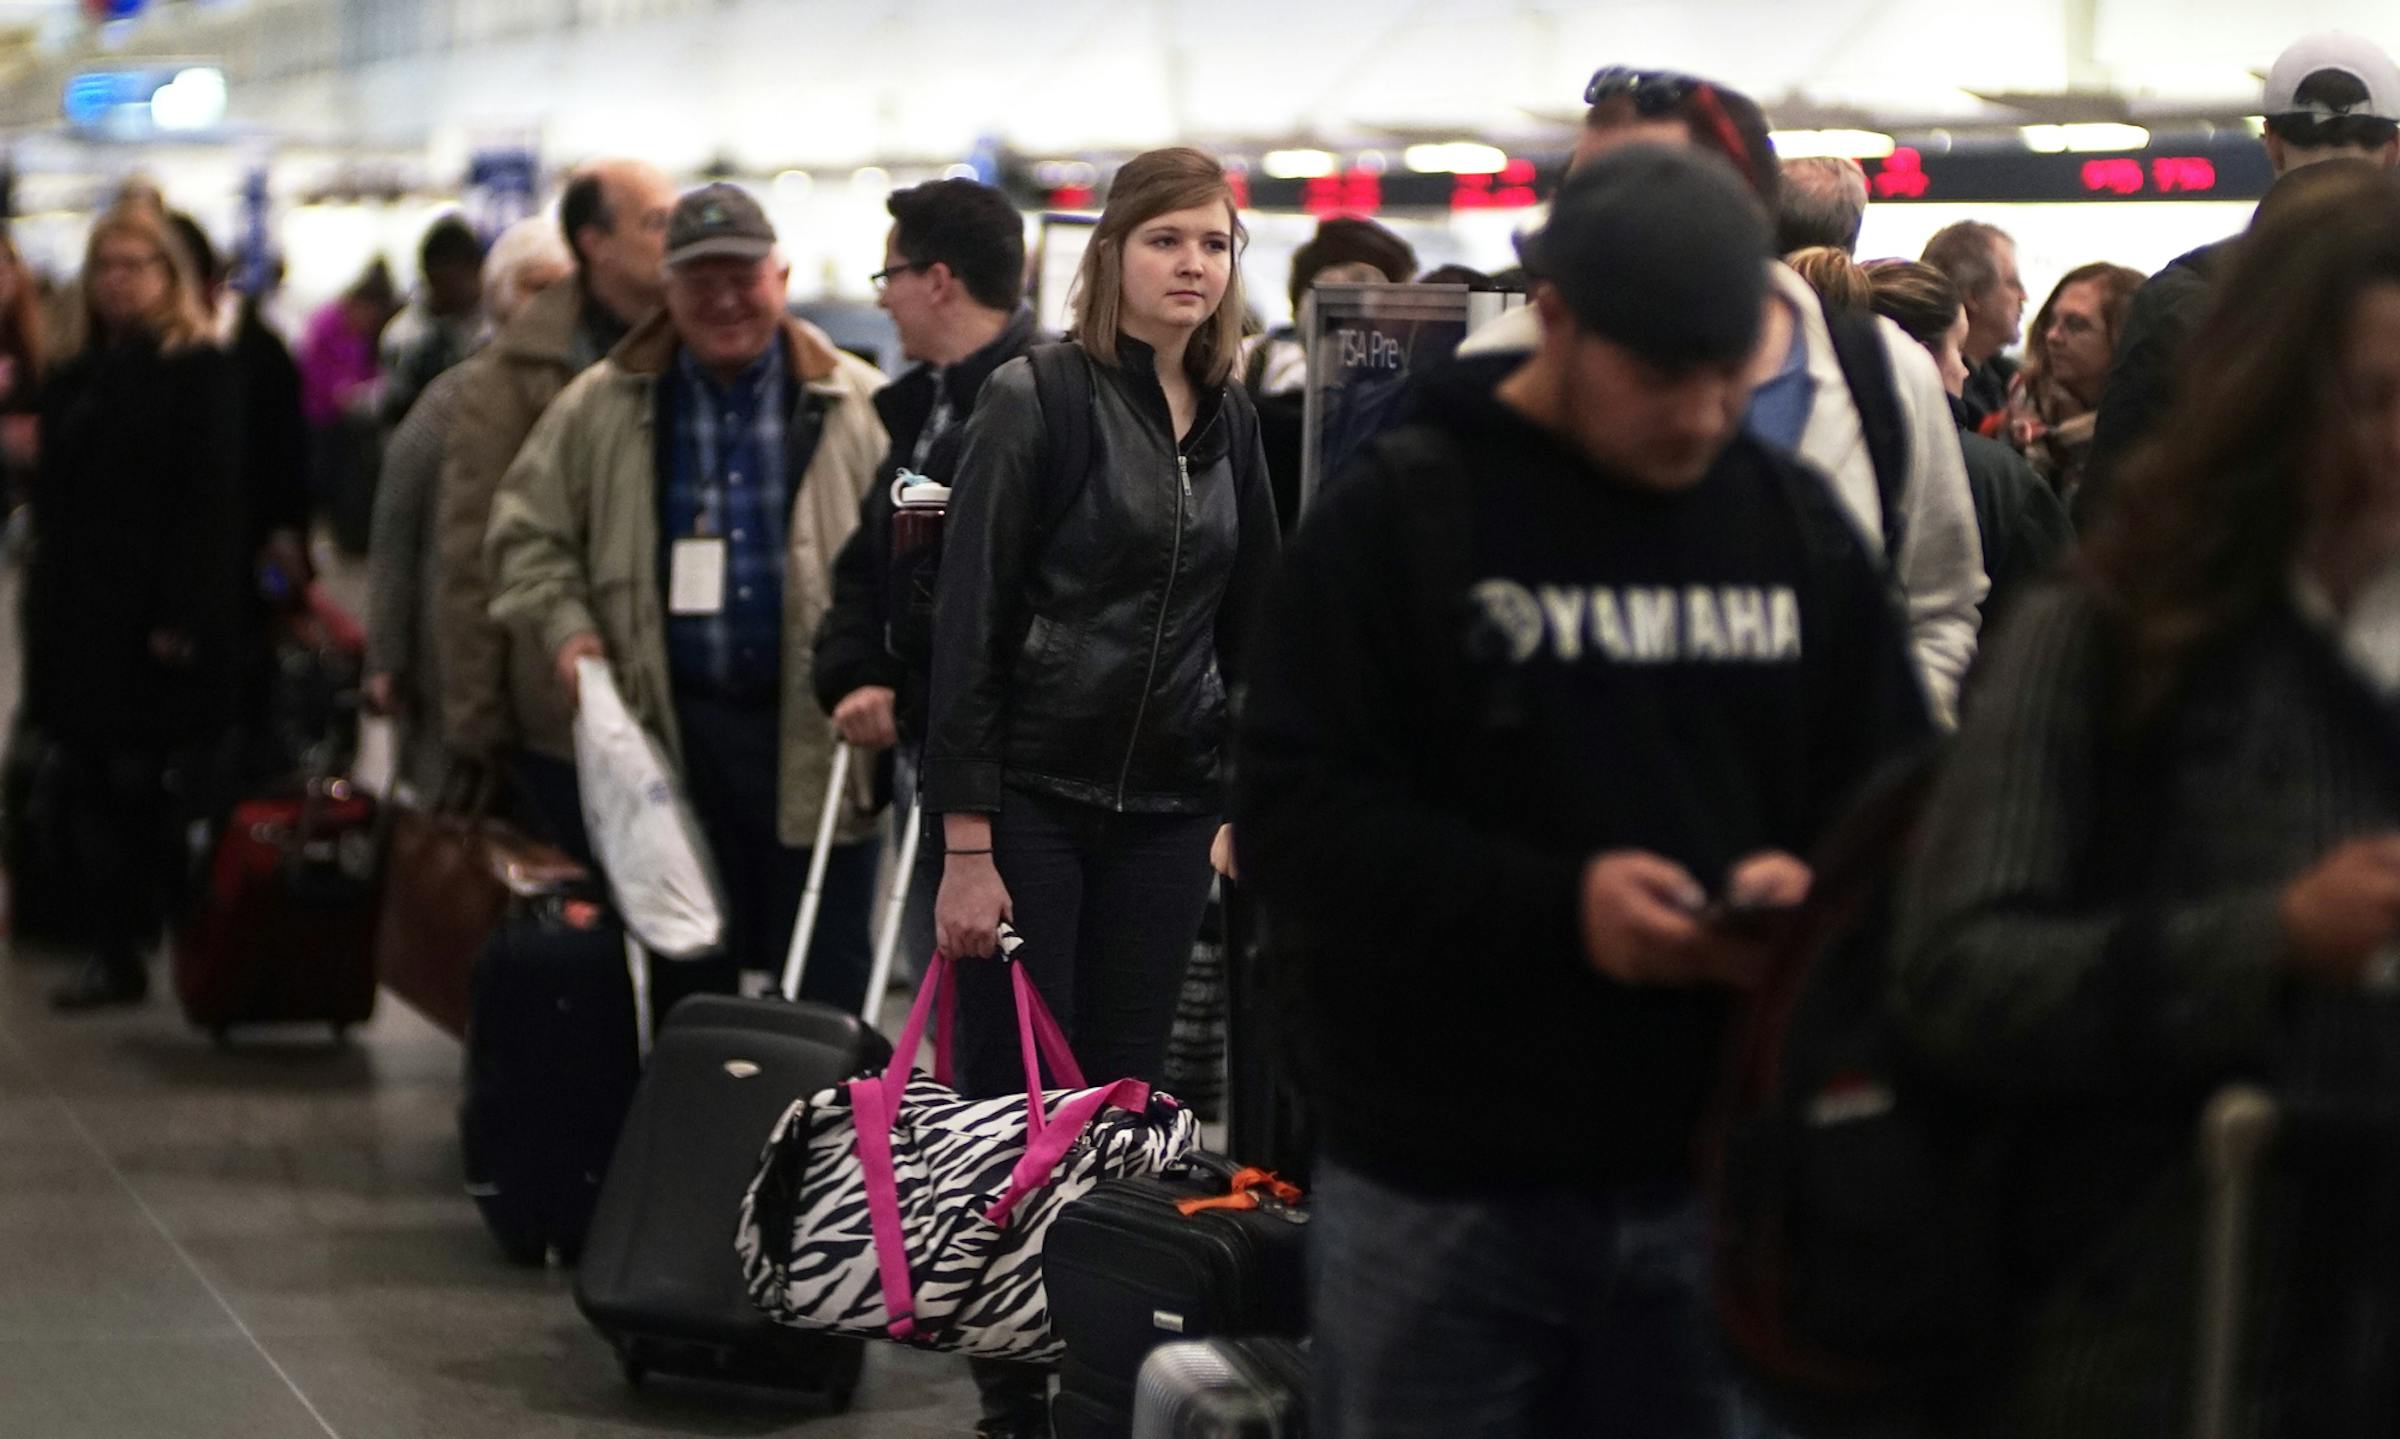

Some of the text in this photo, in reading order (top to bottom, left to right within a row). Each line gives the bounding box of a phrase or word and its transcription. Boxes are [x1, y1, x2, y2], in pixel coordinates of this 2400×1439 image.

[1338, 328, 1399, 369] TSA Pre
[1539, 584, 1800, 661] YAMAHA
